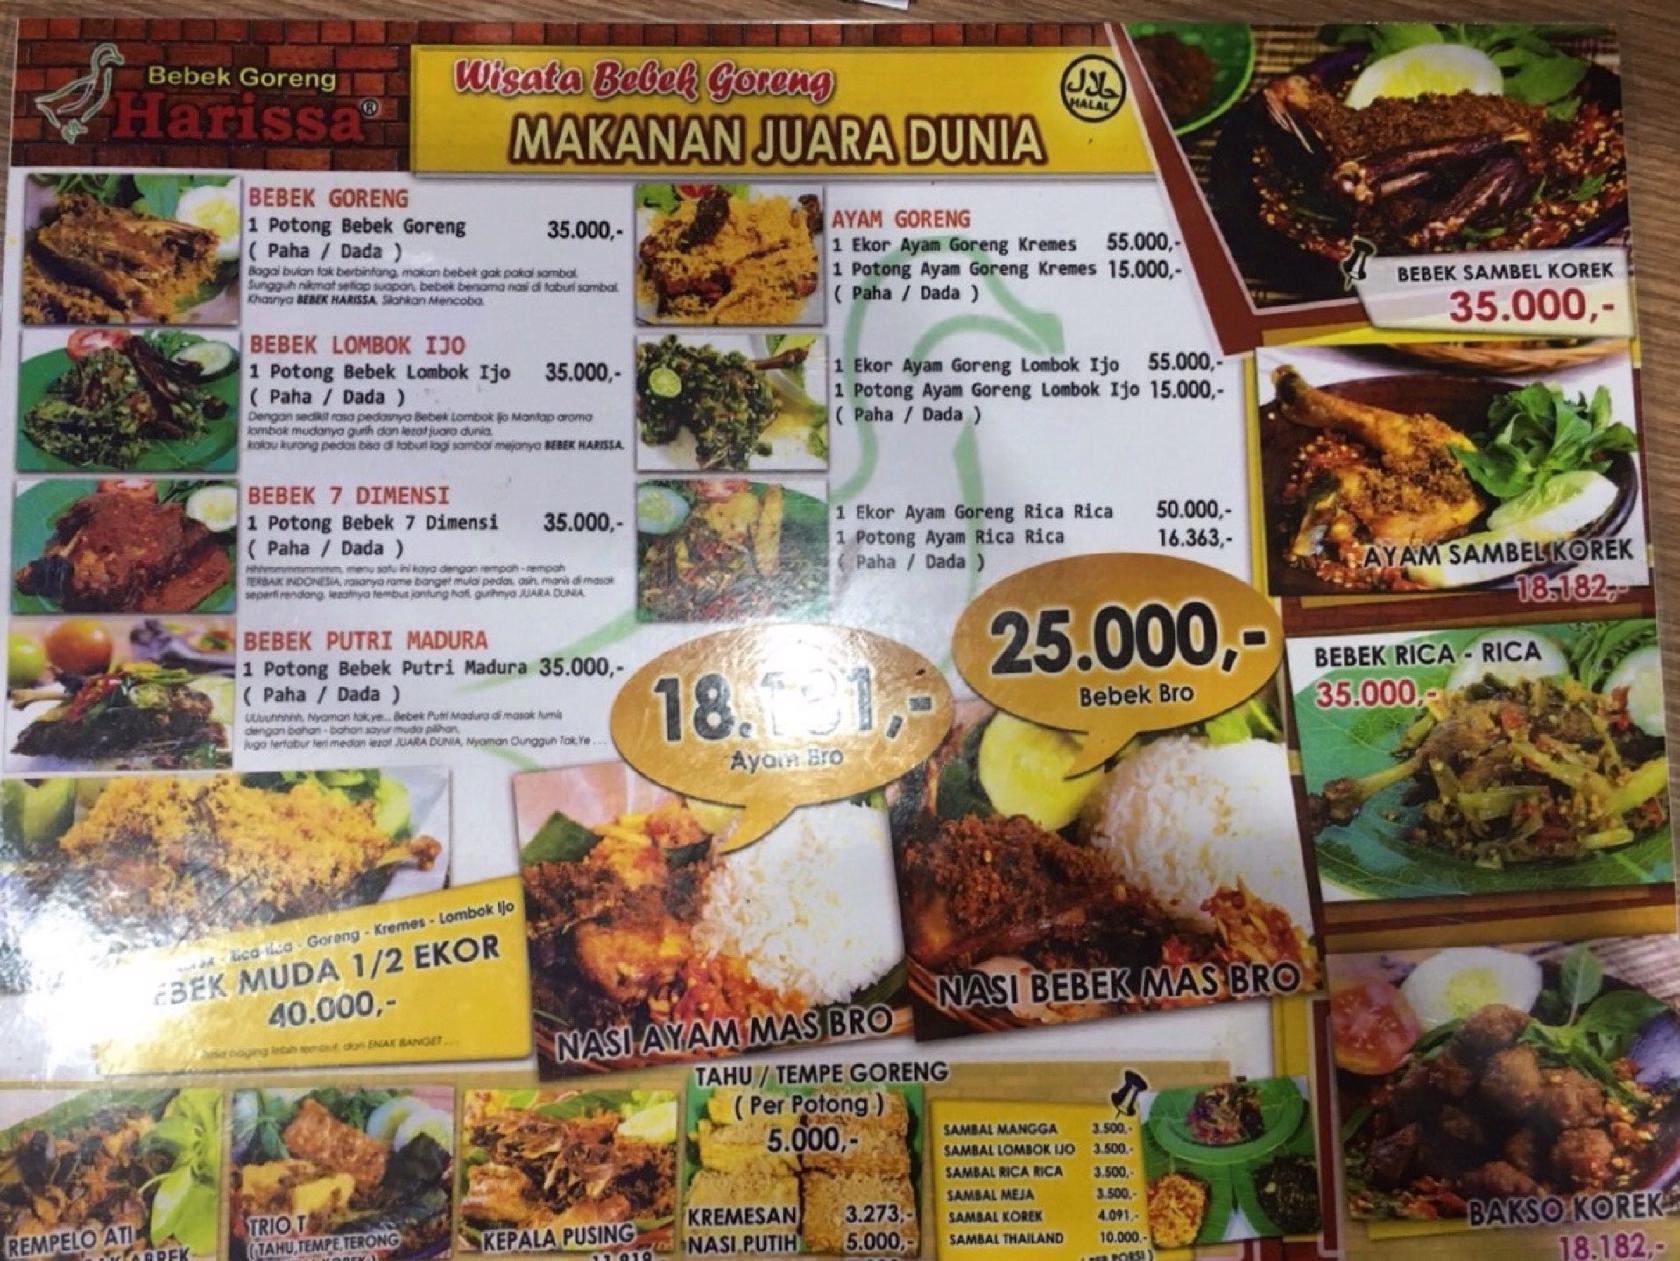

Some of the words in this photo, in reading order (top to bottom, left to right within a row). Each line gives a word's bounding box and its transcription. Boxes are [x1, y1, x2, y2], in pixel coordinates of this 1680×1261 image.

[149, 66, 230, 88] Bebek
[240, 68, 336, 92] Goreng
[455, 58, 583, 98] Wisata
[591, 60, 699, 101] Bebek
[706, 63, 834, 105] Goreng
[1070, 97, 1110, 111] HALAL
[512, 114, 742, 164] MAKANAN
[755, 114, 894, 165] JUARA
[907, 115, 1045, 163] DUNIA
[250, 188, 315, 208] BEBEK
[329, 189, 409, 208] GORENG
[269, 217, 331, 237] Potong
[342, 218, 392, 234] Bebek
[403, 218, 466, 238] Goreng
[547, 221, 623, 240] 35.000,-
[832, 211, 882, 228] AYAM
[895, 211, 970, 228] GORENG
[268, 243, 309, 258] Paha
[341, 243, 382, 258] Dada
[852, 238, 891, 252] Ekor
[901, 239, 940, 256] Ayam
[950, 238, 1008, 256] Goreng
[1019, 238, 1076, 252] Kremes
[1106, 232, 1180, 253] 55.000,-
[443, 267, 477, 278] bebek
[852, 262, 910, 280] Potong
[921, 263, 960, 280] Ayam
[969, 262, 1028, 280] Goreng
[1039, 262, 1096, 276] Kremes
[1108, 261, 1182, 280] 15.000,-
[1398, 266, 1455, 282] BEBEK
[1462, 264, 1542, 280] SAMBEL
[1548, 262, 1614, 279] KOREK
[420, 281, 454, 292] bebek
[852, 285, 892, 300] Paha
[921, 285, 960, 300] Dada
[297, 295, 330, 305] BEBEK
[1450, 288, 1614, 322] 35.000,-
[250, 336, 317, 354] BEBEK
[332, 336, 411, 354] LOMBOK
[426, 336, 466, 354] IJO
[270, 364, 333, 383] Potong
[344, 365, 396, 380] Bebek
[407, 365, 468, 380] Lombok
[479, 364, 510, 383] Ijo
[546, 362, 621, 384] 35.000,-
[854, 358, 892, 372] Ekor
[903, 358, 942, 376] Ayam
[951, 358, 1010, 376] Goreng
[1022, 357, 1080, 372] Lombok
[1090, 357, 1119, 376] Ijo
[270, 389, 311, 404] Paha
[343, 389, 384, 404] Dada
[854, 383, 914, 400] Potong
[922, 383, 962, 400] Ayam
[971, 382, 1031, 400] Goreng
[1041, 382, 1100, 397] Lombok
[1110, 381, 1140, 400] Ijo
[415, 412, 448, 422] Bebek
[451, 412, 494, 422] Lombok
[854, 407, 893, 422] Paha
[923, 407, 962, 422] Dada
[378, 425, 398, 435] dan
[545, 440, 575, 450] BEBEK
[249, 486, 315, 504] BEBEK
[356, 486, 449, 504] DIMENSI
[856, 505, 894, 519] Ekor
[906, 505, 945, 523] Ayam
[954, 504, 1014, 523] Goreng
[1024, 504, 1064, 519] Rica
[1074, 504, 1112, 519] Rica
[269, 516, 332, 534] Potong
[342, 516, 394, 530] Bebek
[426, 514, 498, 530] Dimensi
[268, 540, 310, 555] Paha
[342, 540, 384, 555] Dada
[856, 530, 916, 548] Potong
[926, 530, 965, 548] Ayam
[976, 530, 1015, 544] Rica
[1025, 530, 1064, 544] Rica
[857, 554, 896, 569] Paha
[926, 554, 965, 569] Dada
[1363, 544, 1441, 567] AYAM
[1450, 542, 1544, 564] SAMBEL
[1554, 538, 1633, 560] KOREK
[1516, 574, 1628, 601] 18.182,-
[244, 632, 311, 650] BEBEK
[327, 632, 392, 650] PUTRI
[407, 630, 488, 650] MADURA
[991, 602, 1265, 674] 25.000,-
[1314, 646, 1387, 667] BEBEK
[1395, 644, 1455, 665] RICA
[1482, 640, 1542, 662] RICA
[264, 662, 328, 680] Potong
[338, 661, 391, 676] Bebek
[402, 660, 454, 676] Putri
[465, 660, 527, 675] Madura
[264, 687, 306, 702] Paha
[338, 686, 380, 702] Dada
[1080, 687, 1151, 707] Bebek
[1159, 685, 1194, 704] Bro
[394, 711, 424, 721] Bebek
[395, 737, 427, 747] JUARA
[374, 918, 426, 936] Kremes
[439, 906, 494, 924] Lombok
[239, 958, 340, 994] MUDA
[352, 948, 403, 979] 1/2
[415, 935, 500, 969] EKOR
[938, 977, 1018, 1008] NASI
[1031, 969, 1131, 1001] BEBEK
[1141, 966, 1218, 997] MAS
[1229, 964, 1300, 993] BRO
[268, 990, 396, 1028] 40.000,-
[556, 1028, 631, 1062] NASI
[643, 1019, 738, 1054] AYAM
[750, 1011, 818, 1043] MAS
[831, 1006, 893, 1036] BRO
[696, 1066, 752, 1086] TAHU
[776, 1064, 848, 1084] TEMPE
[850, 1061, 948, 1083] GORENG
[751, 1096, 785, 1115] Per
[791, 1094, 867, 1117] Potong
[944, 1124, 993, 1136] SAMBAL
[997, 1124, 1058, 1135] MANGGA
[944, 1144, 993, 1156] SAMBAL
[998, 1144, 1051, 1155] LOMBOK
[946, 1167, 996, 1178] SAMBAL
[947, 1190, 997, 1202] SAMBAL
[688, 1206, 796, 1226] KREMESAN
[949, 1211, 998, 1223] SAMBAL
[1003, 1210, 1043, 1222] KOREK
[1470, 1198, 1564, 1226] BAKSO
[1574, 1192, 1664, 1221] KOREK
[250, 1217, 291, 1236] TRIO
[9, 1230, 96, 1257] REMPELO
[104, 1226, 132, 1246] ATI
[483, 1230, 556, 1252] KEPALA
[564, 1222, 634, 1246] PUSING
[688, 1235, 738, 1254] NASI
[744, 1235, 797, 1254] PUTIH
[950, 1234, 1000, 1245] SAMBAL
[1004, 1232, 1064, 1244] THAILAND
